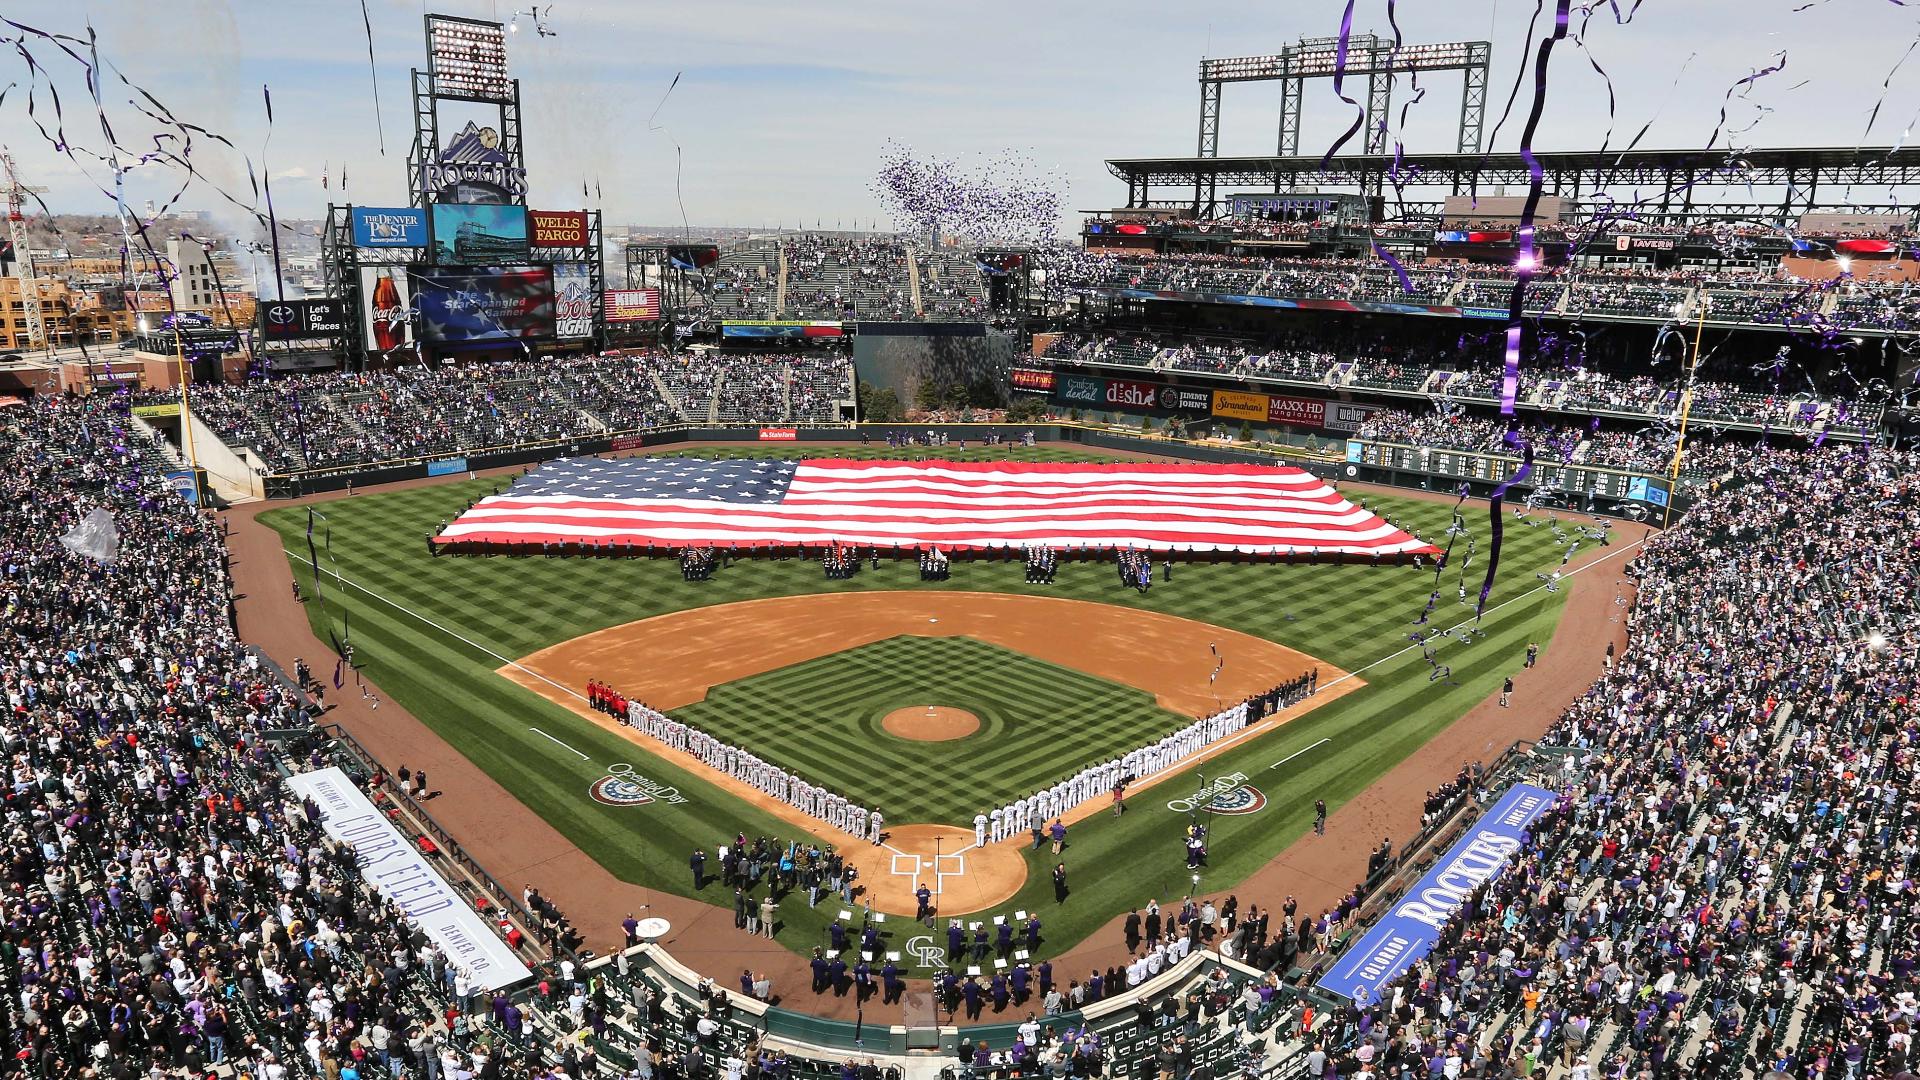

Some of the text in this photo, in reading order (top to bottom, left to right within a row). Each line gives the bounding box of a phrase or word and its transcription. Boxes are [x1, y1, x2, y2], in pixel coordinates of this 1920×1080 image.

[421, 165, 529, 195] ROCKIES
[363, 214, 418, 224] THE DENVER
[535, 217, 580, 230] WELLS
[536, 230, 580, 241] FARGO
[1633, 239, 1674, 248] TAVERN
[456, 290, 478, 300] The
[614, 292, 648, 306] KING
[309, 306, 330, 314] Let's
[554, 291, 592, 320] Coors
[309, 314, 322, 322] Go
[1463, 311, 1510, 320] OfficeLiquidators.co
[311, 322, 340, 331] Places
[556, 320, 592, 336] LIGHT
[1065, 388, 1098, 401] dental
[1106, 383, 1146, 405] dish
[1179, 392, 1208, 401] JIMMY
[1179, 400, 1208, 409] JOHN'S
[1216, 396, 1263, 412] Stranahan's
[1270, 399, 1324, 414] MAXX HD
[1269, 409, 1323, 420] sunglasses
[1339, 407, 1366, 422] weber
[608, 763, 688, 804] Opening Day
[315, 781, 340, 805] WELCOME
[1167, 772, 1249, 812] Opening Day
[1504, 808, 1526, 827] SINCE
[334, 814, 453, 918] COORS FIELD
[1395, 830, 1521, 931] ROCKIES
[440, 924, 490, 974] DENVER, CO.
[906, 936, 949, 967] CR
[1359, 937, 1409, 981] COLORADO
